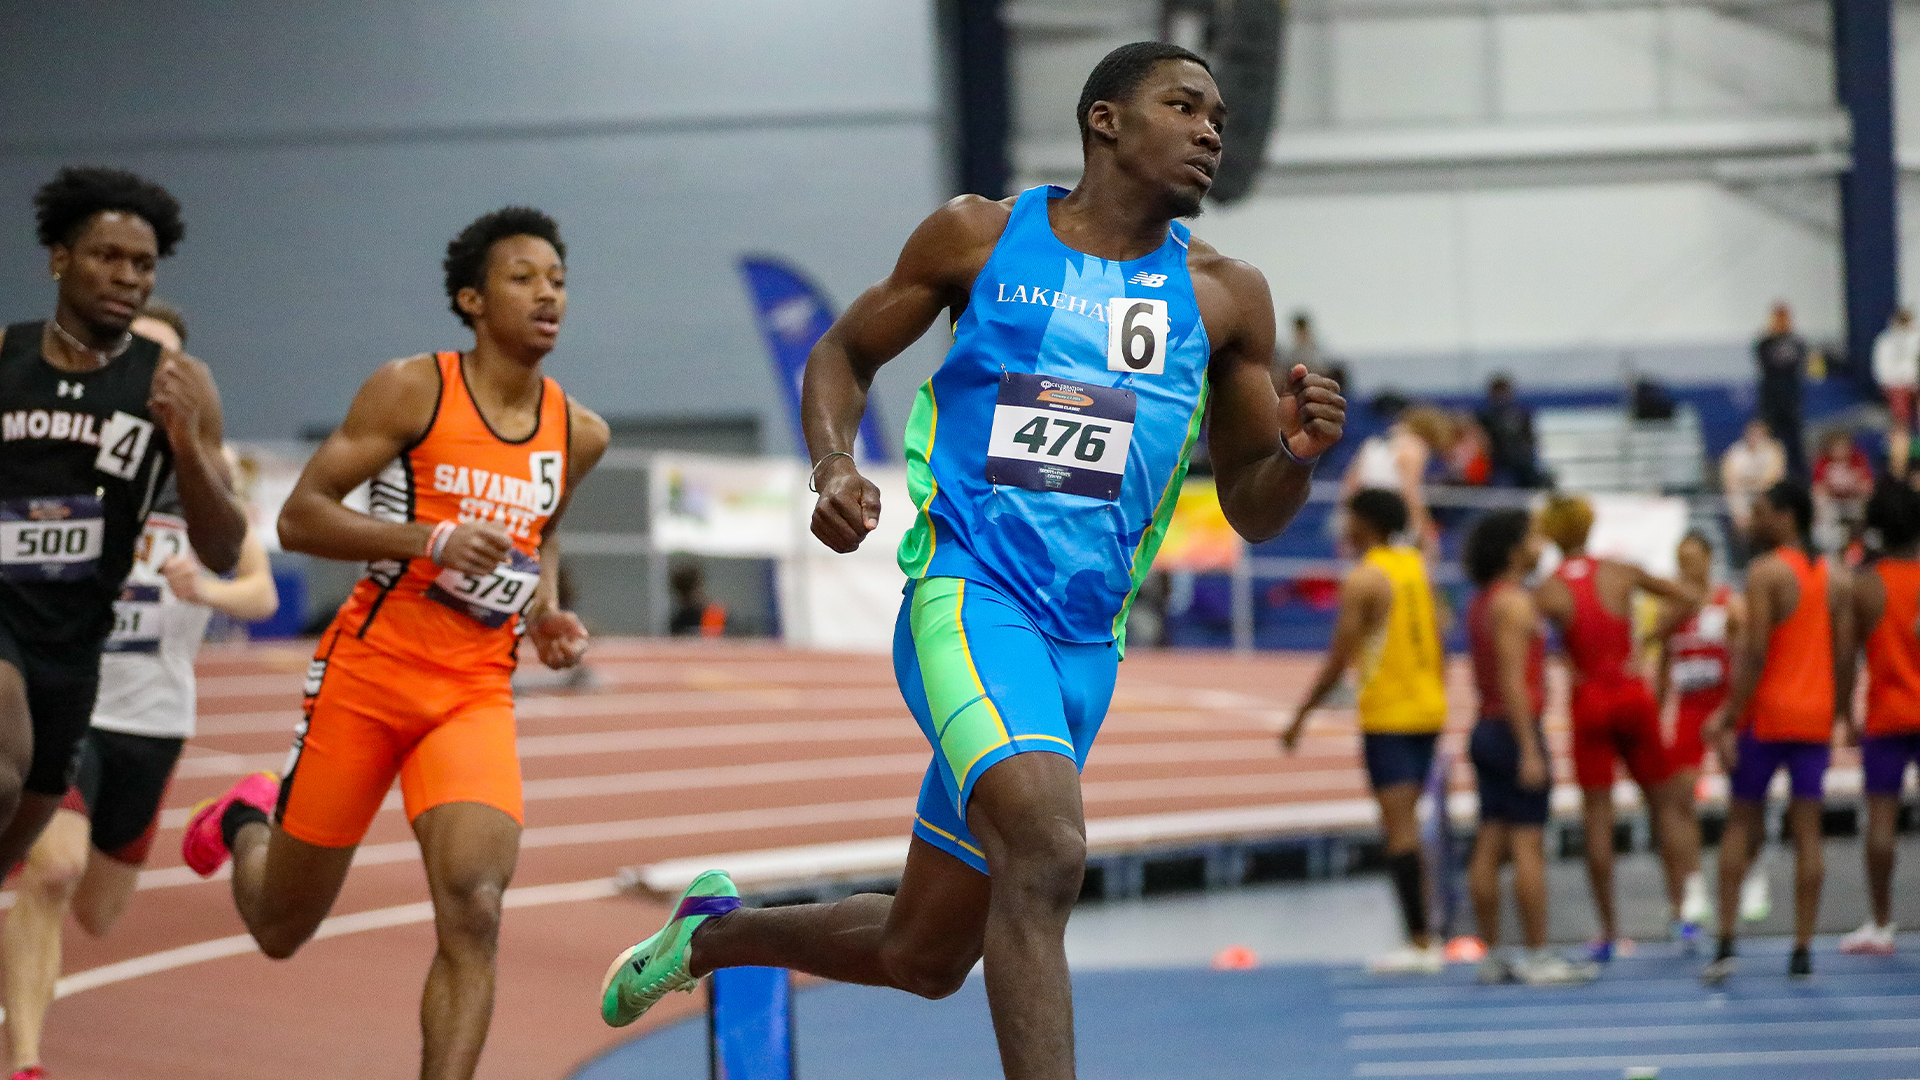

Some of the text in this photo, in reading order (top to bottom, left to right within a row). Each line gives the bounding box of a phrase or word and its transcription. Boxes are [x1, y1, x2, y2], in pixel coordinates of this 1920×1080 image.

[1120, 302, 1156, 370] 6
[109, 425, 142, 471] 4
[1013, 415, 1112, 463] 476
[434, 464, 536, 510] SAVANN
[540, 458, 556, 511] 5
[457, 497, 538, 538] STATE
[16, 527, 88, 557] 500
